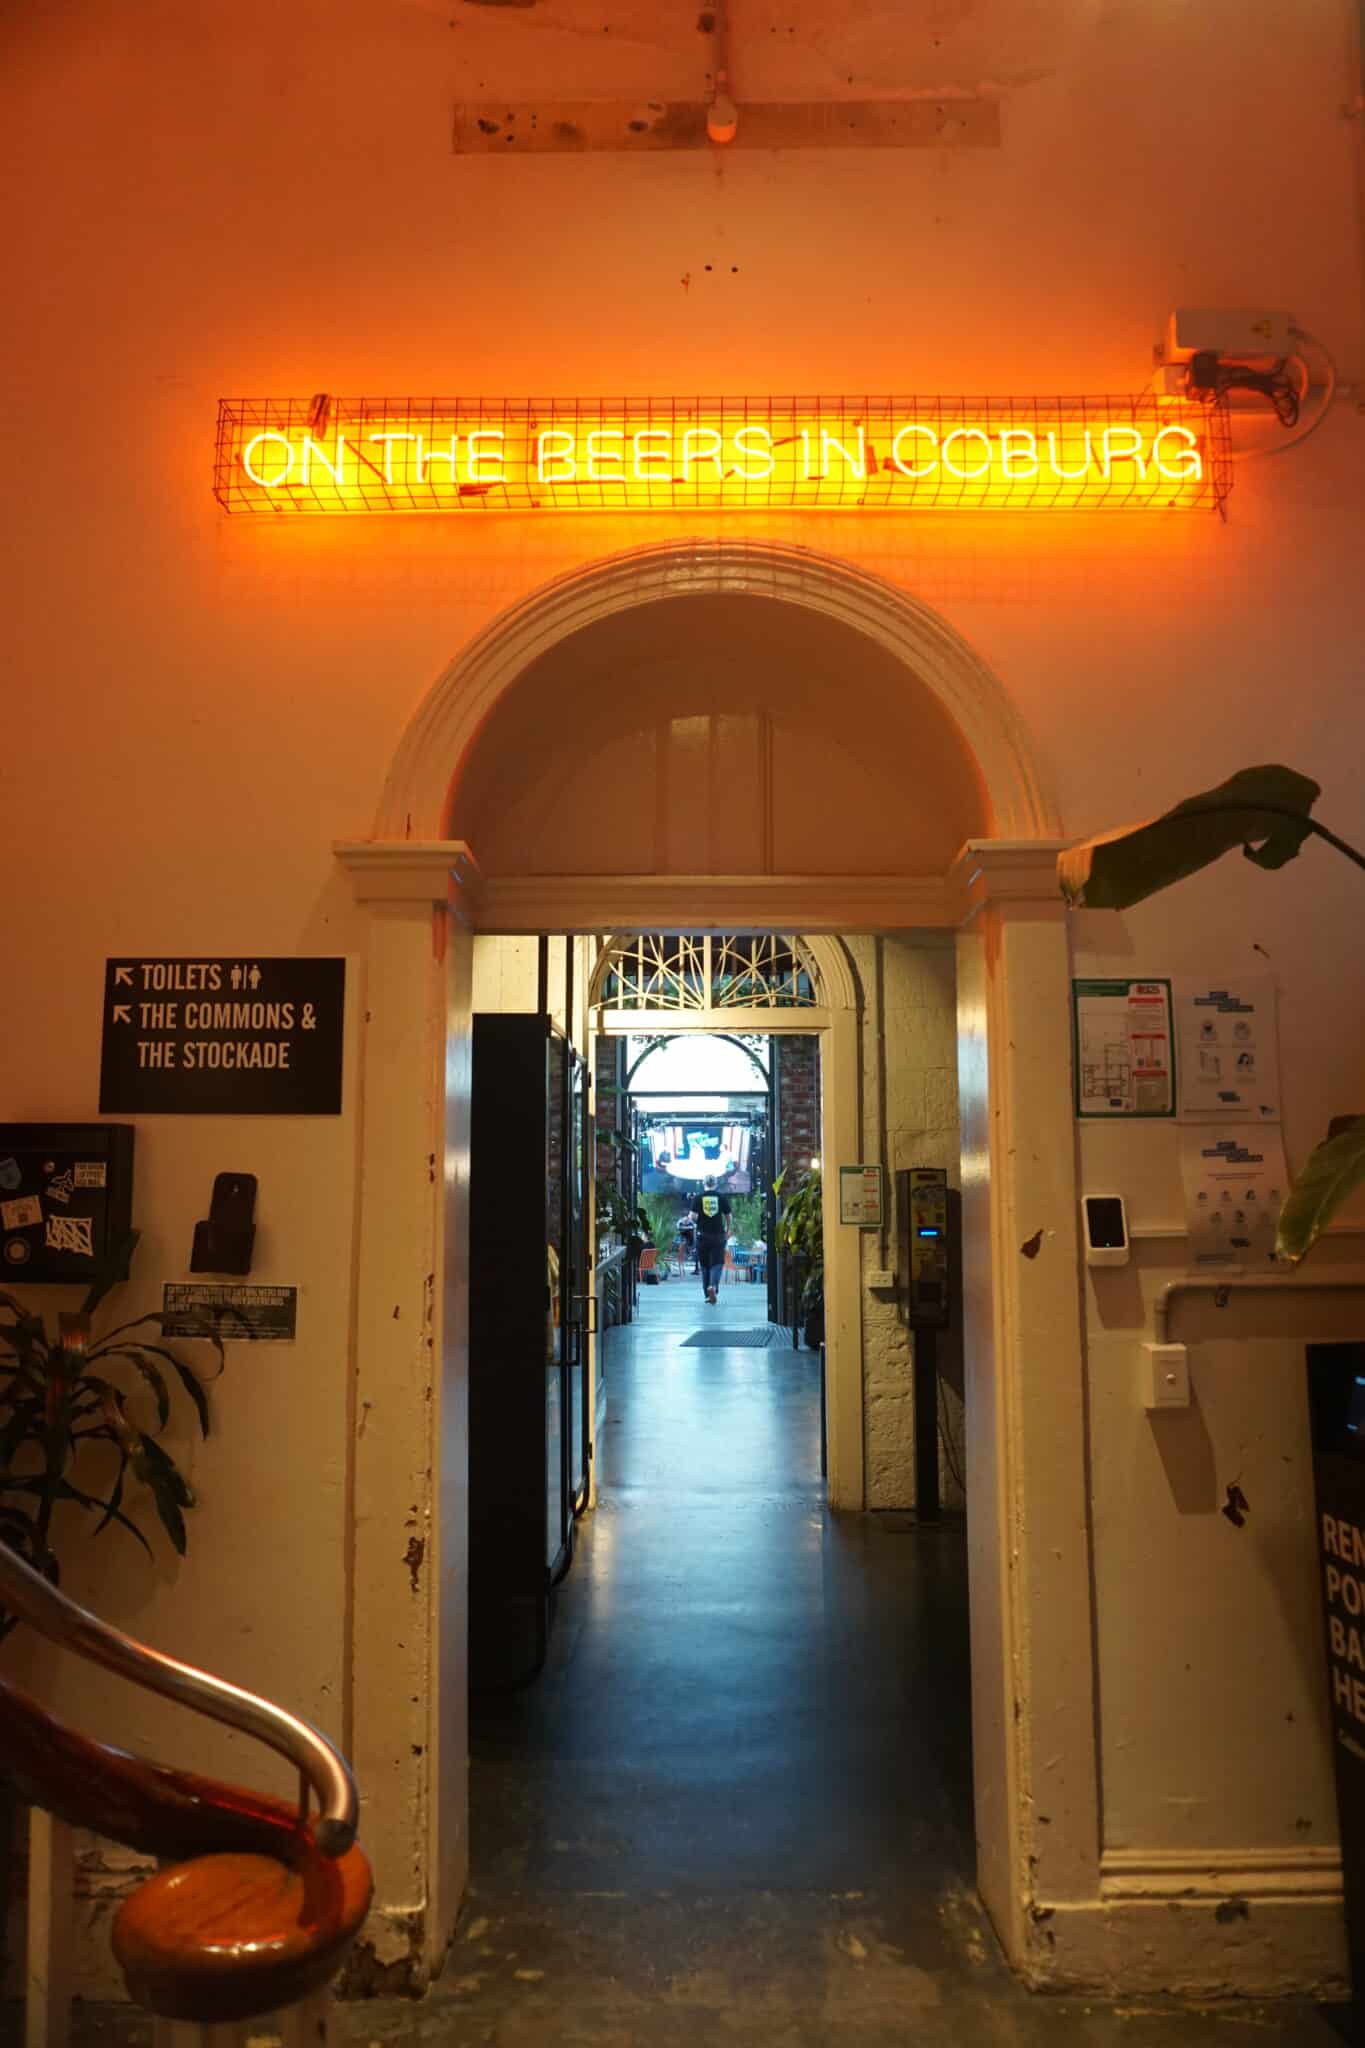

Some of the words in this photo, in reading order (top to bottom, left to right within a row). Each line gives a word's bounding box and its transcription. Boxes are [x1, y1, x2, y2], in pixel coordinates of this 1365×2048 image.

[243, 432, 345, 488] ON
[369, 430, 507, 484] THE
[537, 426, 775, 483] BEERS
[801, 425, 866, 479] IN
[892, 425, 1203, 481] COBURG
[141, 964, 222, 991] TOILETS
[139, 1003, 178, 1029] THE
[185, 1002, 295, 1030] COMMONS
[301, 1003, 317, 1030] &
[137, 1042, 176, 1068] THE
[182, 1042, 291, 1069] STOCKADE
